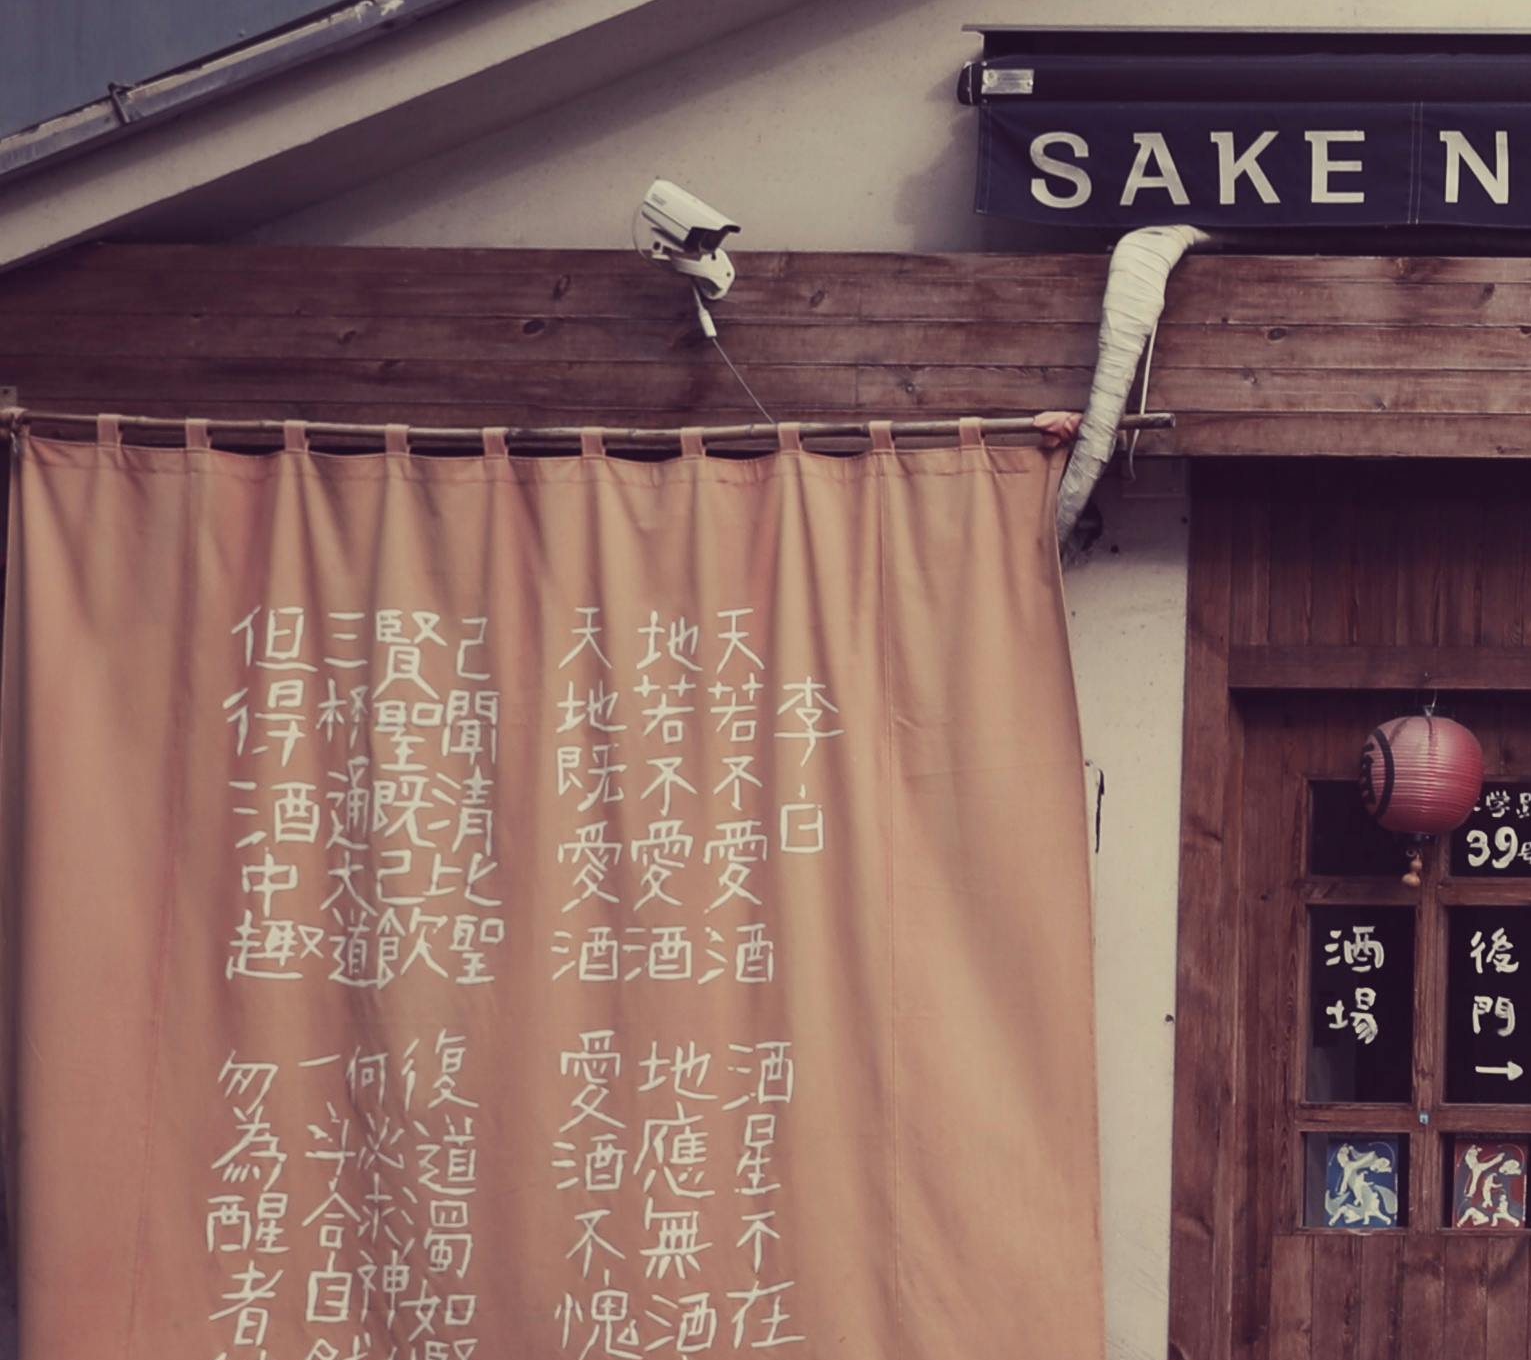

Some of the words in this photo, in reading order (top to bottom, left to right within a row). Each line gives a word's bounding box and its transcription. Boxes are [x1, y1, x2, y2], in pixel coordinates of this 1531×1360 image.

[1028, 129, 1366, 207] SAKE
[223, 605, 325, 981] 但得酒中趣
[551, 607, 628, 982] 天地既愛酒
[622, 610, 702, 981] 地若不愛酒
[698, 607, 773, 985] 天若不愛酒
[774, 676, 845, 853] 李白
[1324, 925, 1385, 1045] 酒場
[1469, 927, 1519, 1037] 後門
